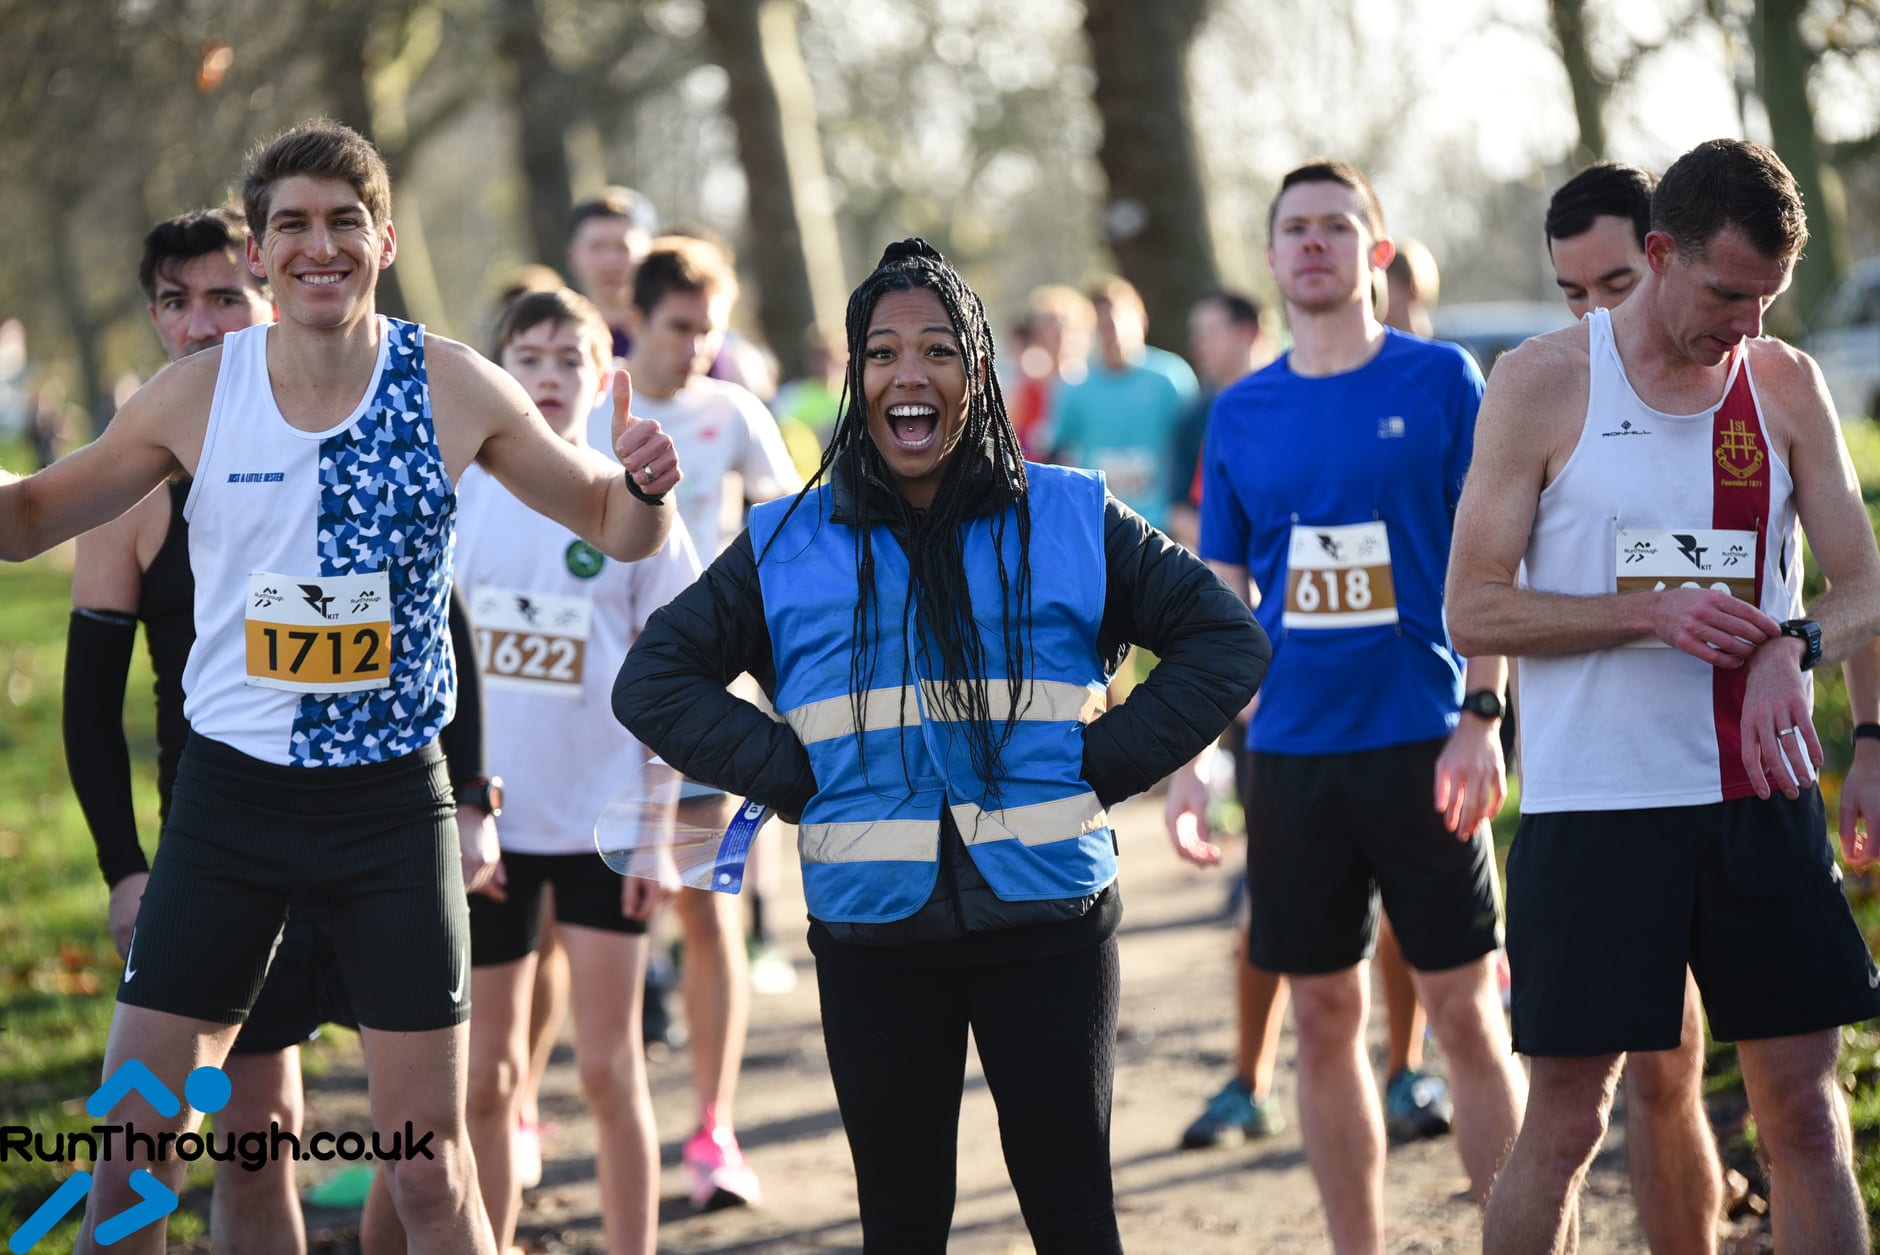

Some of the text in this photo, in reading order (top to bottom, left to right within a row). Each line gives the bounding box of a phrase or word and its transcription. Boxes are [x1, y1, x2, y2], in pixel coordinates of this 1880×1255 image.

[1296, 568, 1372, 612] 618
[263, 628, 380, 675] 1712
[479, 630, 576, 680] 1622
